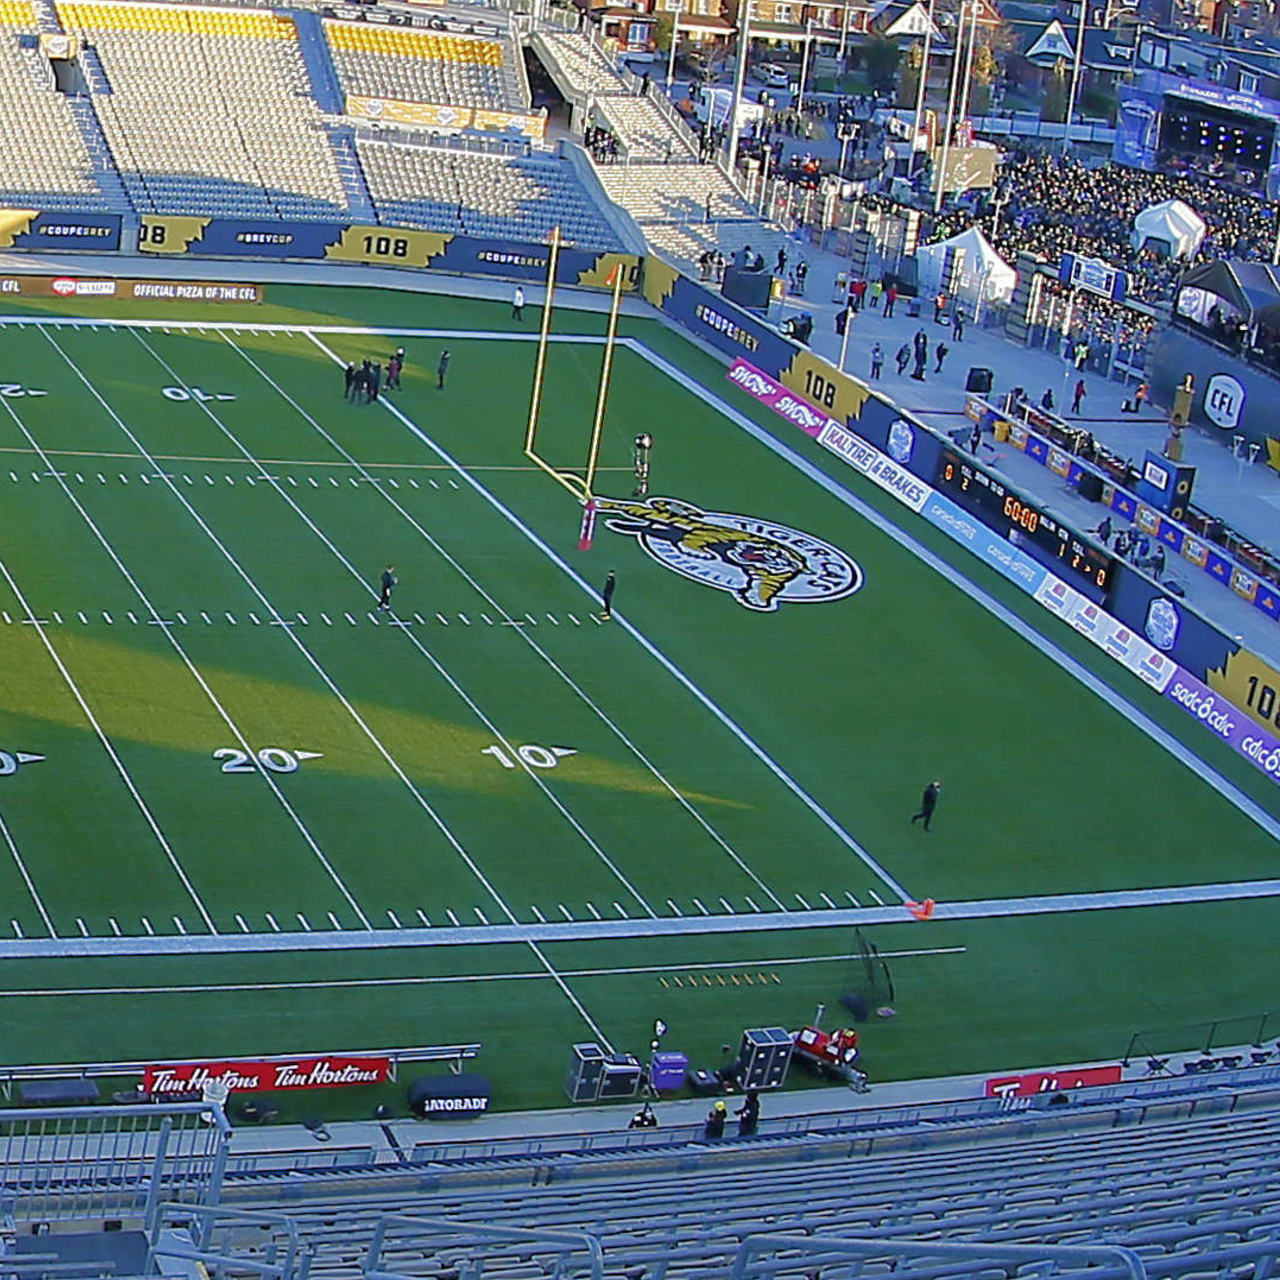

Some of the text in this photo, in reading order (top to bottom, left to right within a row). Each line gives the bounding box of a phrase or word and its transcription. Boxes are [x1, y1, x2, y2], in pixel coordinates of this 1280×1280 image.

[362, 235, 409, 258] 108
[2, 280, 21, 293] CFL
[134, 283, 257, 300] OFFICIAL PIZZA OF THE CFL
[161, 385, 215, 403] 10
[804, 370, 835, 408] 108
[1209, 387, 1234, 417] CFL
[871, 460, 883, 476] &
[878, 463, 925, 505] BRAKES
[961, 478, 969, 491] 2
[1003, 496, 1038, 533] 60:00
[734, 519, 846, 593] TIGER-CATS
[1058, 543, 1065, 557] 1
[1072, 555, 1080, 568] 2
[1096, 569, 1106, 587] 0
[1170, 682, 1201, 712] sadc
[1207, 708, 1235, 737] cdic
[211, 747, 299, 774] 20
[480, 743, 559, 770] 10
[153, 1068, 260, 1091] Tim Hortons
[274, 1062, 379, 1086] Tim Hortons
